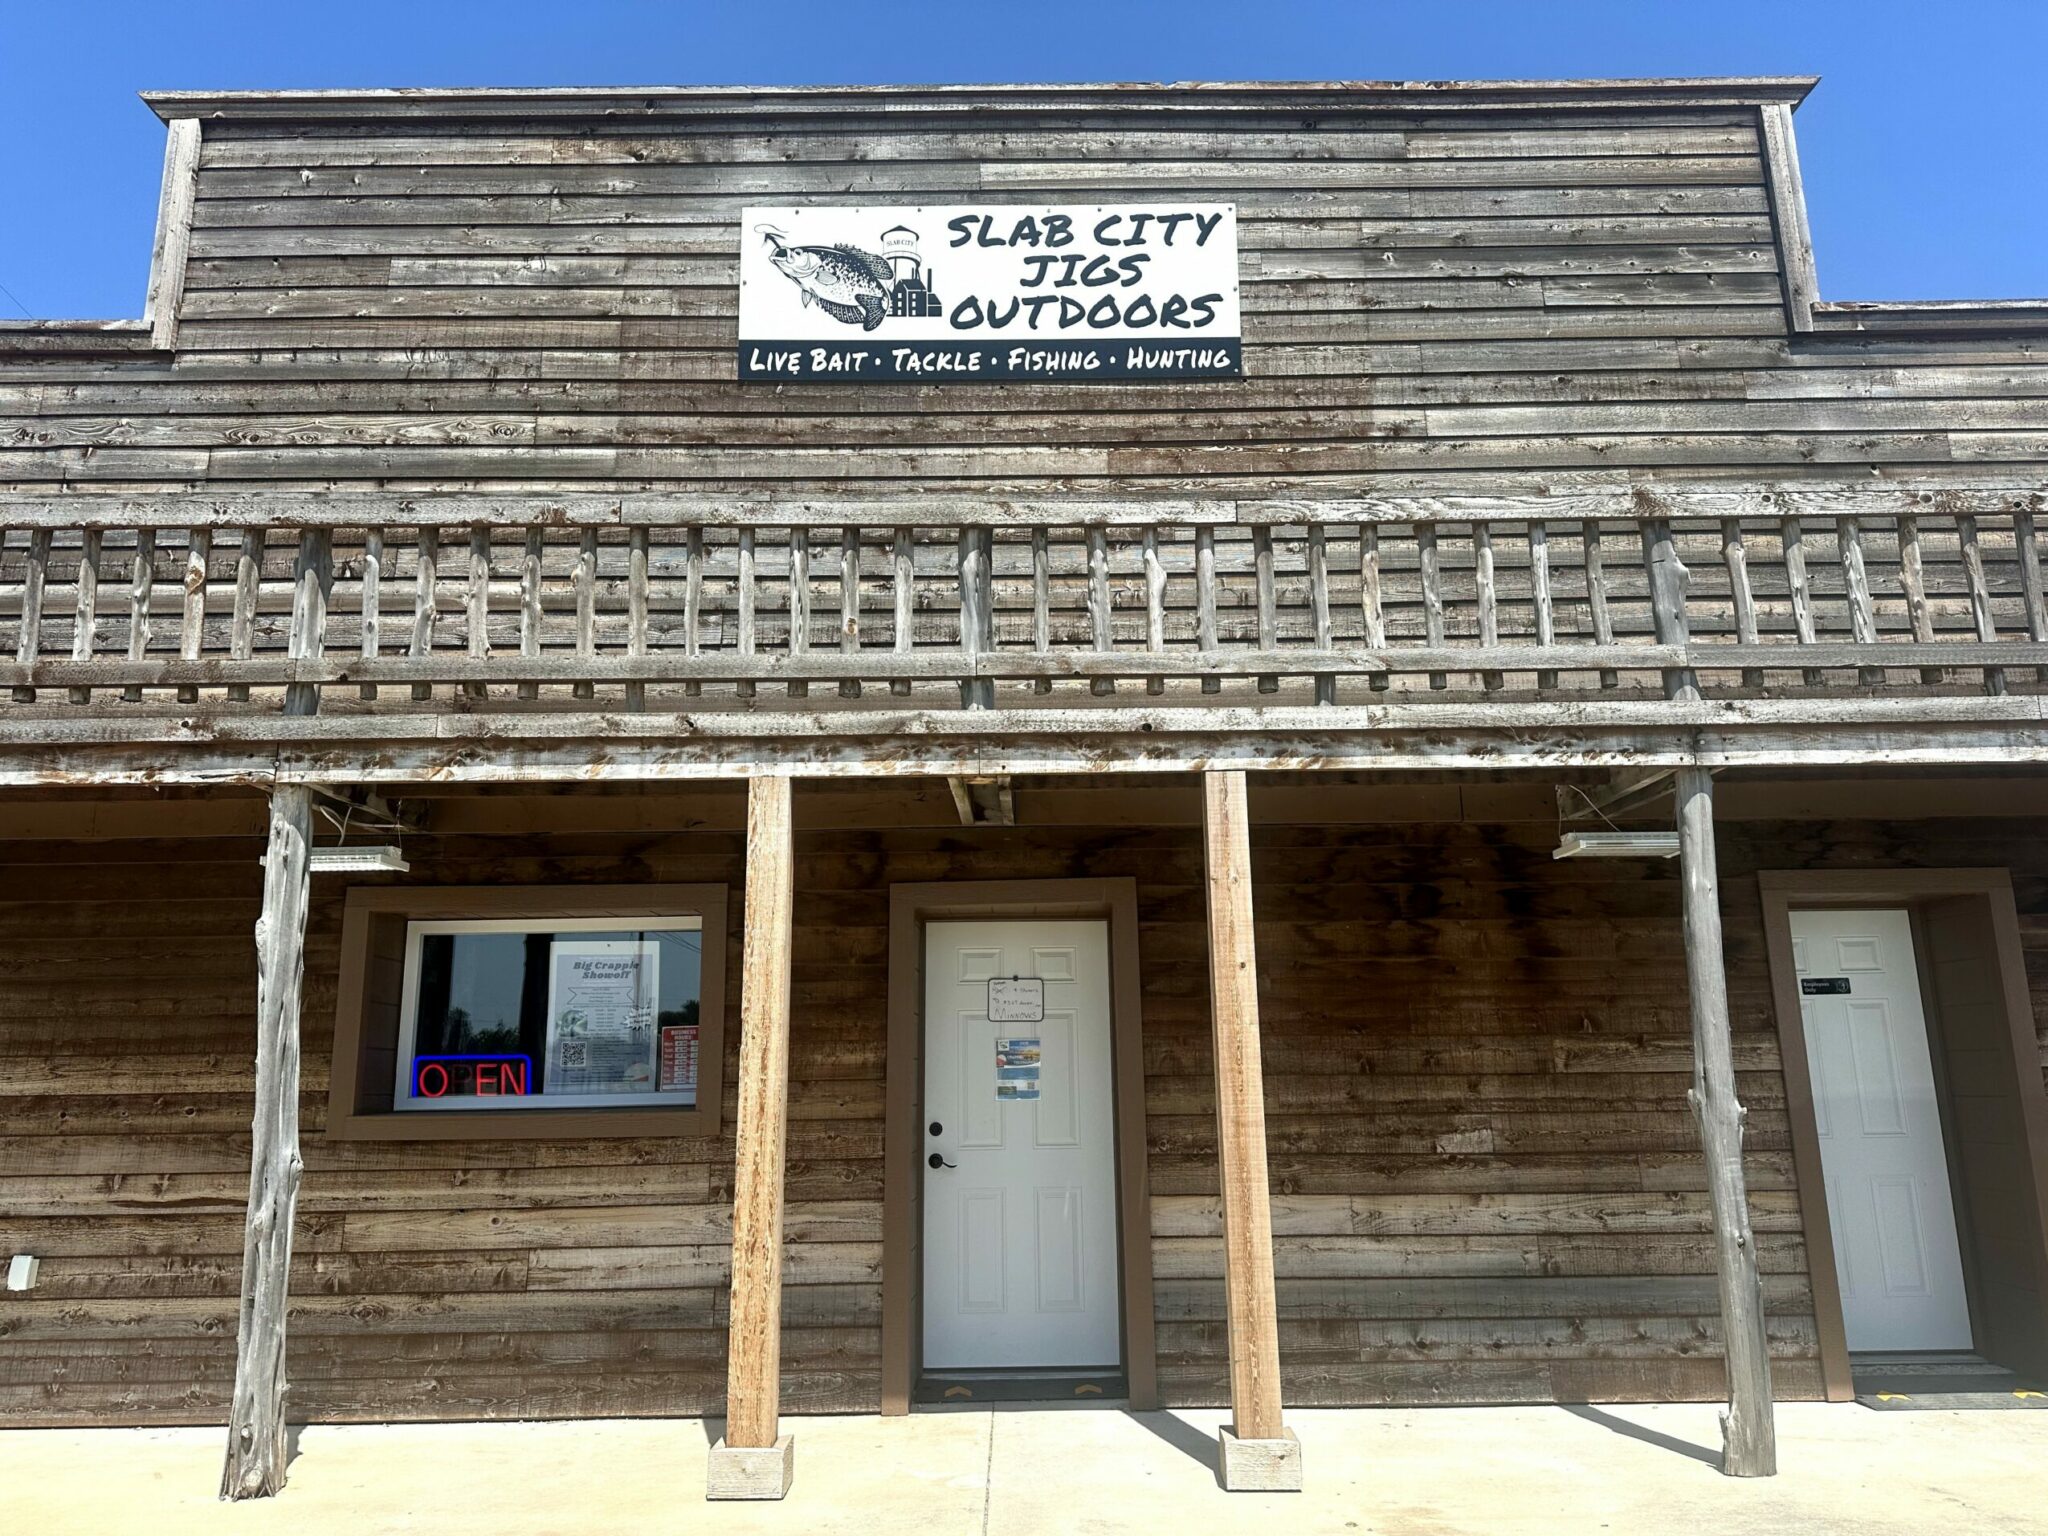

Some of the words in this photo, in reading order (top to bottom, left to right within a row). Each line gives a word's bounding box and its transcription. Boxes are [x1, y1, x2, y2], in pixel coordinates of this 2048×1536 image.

[948, 211, 1074, 247] SLAB
[1094, 210, 1222, 246] CITY
[901, 239, 914, 248] CITY
[1020, 254, 1151, 287] JIGS
[950, 294, 1223, 330] OUTDOORS
[749, 347, 801, 372] LIVE
[810, 348, 868, 371] BAIT
[892, 348, 981, 371] TACKLE
[1008, 347, 1100, 370] FISHING
[1127, 346, 1230, 369] HUNTING
[573, 961, 593, 971] Big
[582, 970, 632, 980] Showoff
[418, 1062, 526, 1098] OPEN
